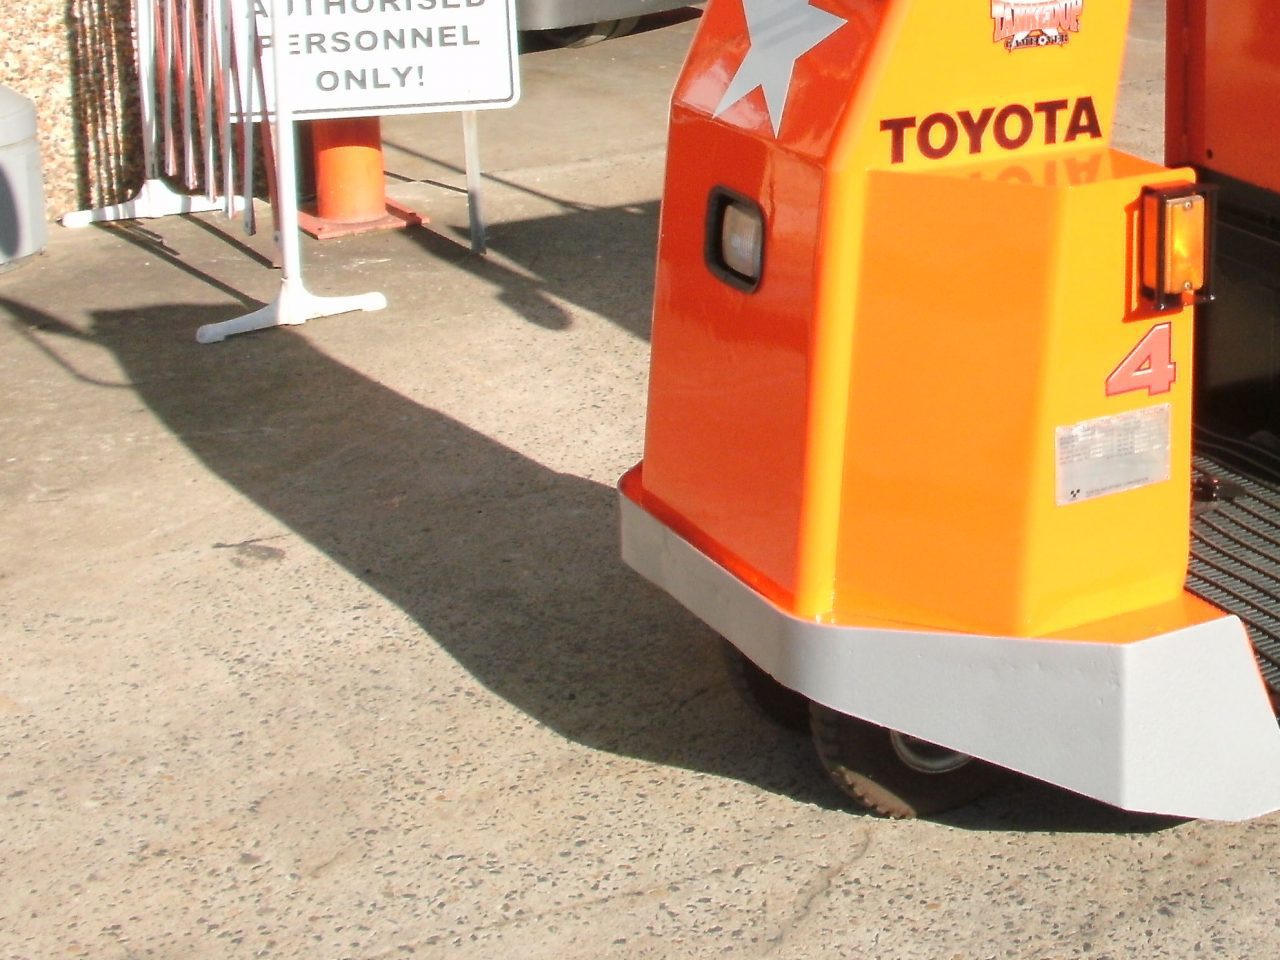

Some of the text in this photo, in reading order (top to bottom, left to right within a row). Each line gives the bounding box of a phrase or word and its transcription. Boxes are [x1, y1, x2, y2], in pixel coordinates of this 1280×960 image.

[316, 65, 425, 92] ONLY!
[879, 96, 1103, 164] TOYOTA
[1105, 321, 1177, 397] 4
